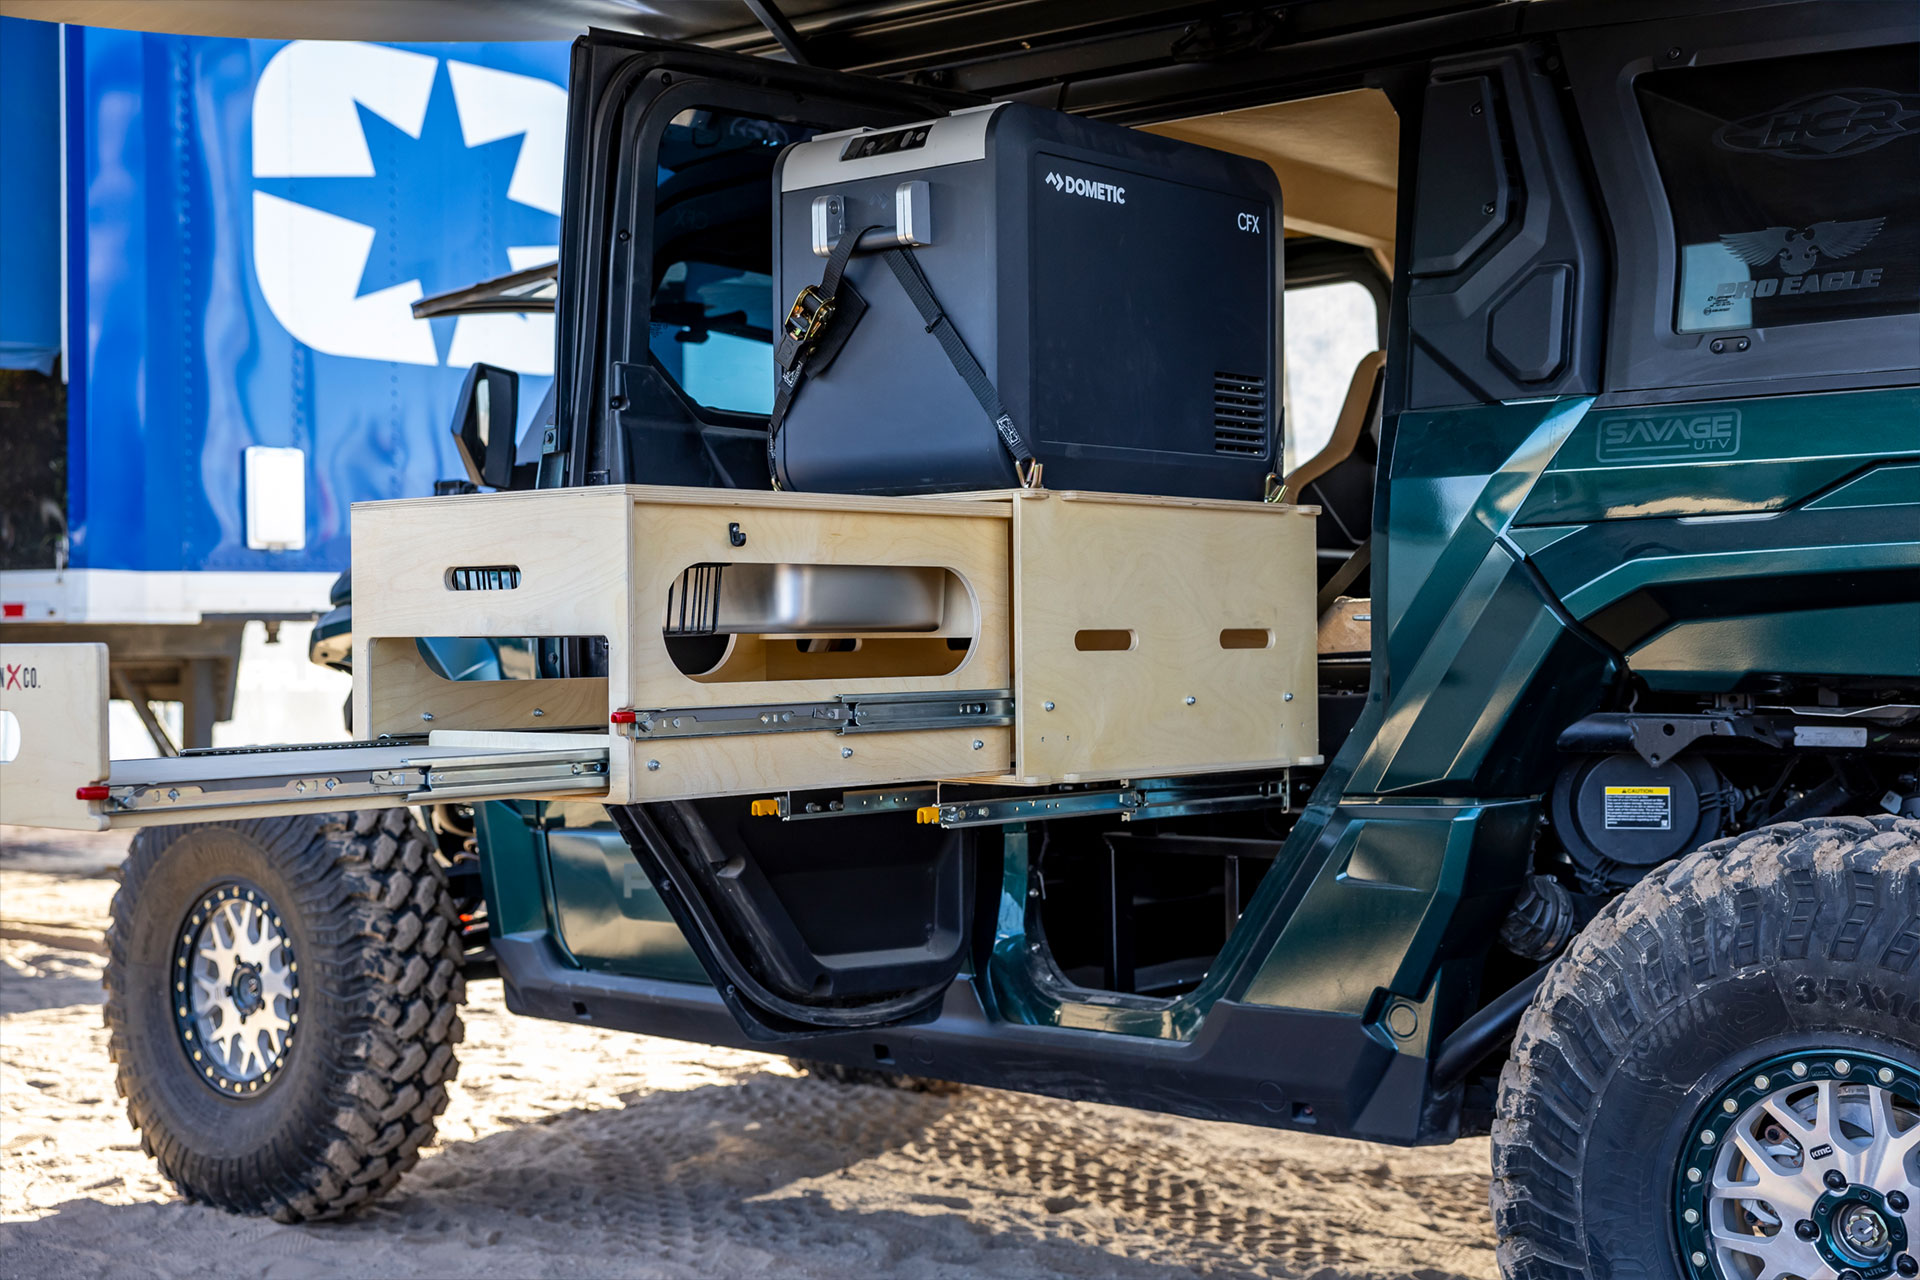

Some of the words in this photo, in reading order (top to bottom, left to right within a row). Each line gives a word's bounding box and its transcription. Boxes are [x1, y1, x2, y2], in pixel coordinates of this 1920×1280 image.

[1762, 100, 1906, 146] HCR
[1065, 175, 1126, 204] DOMETIC
[1237, 212, 1260, 234] CFX
[1716, 278, 1778, 299] PRO
[1780, 268, 1883, 296] EAGLE
[1606, 415, 1733, 445] SAVAGE
[1694, 438, 1731, 450] UTV
[1811, 1146, 1832, 1158] KMC
